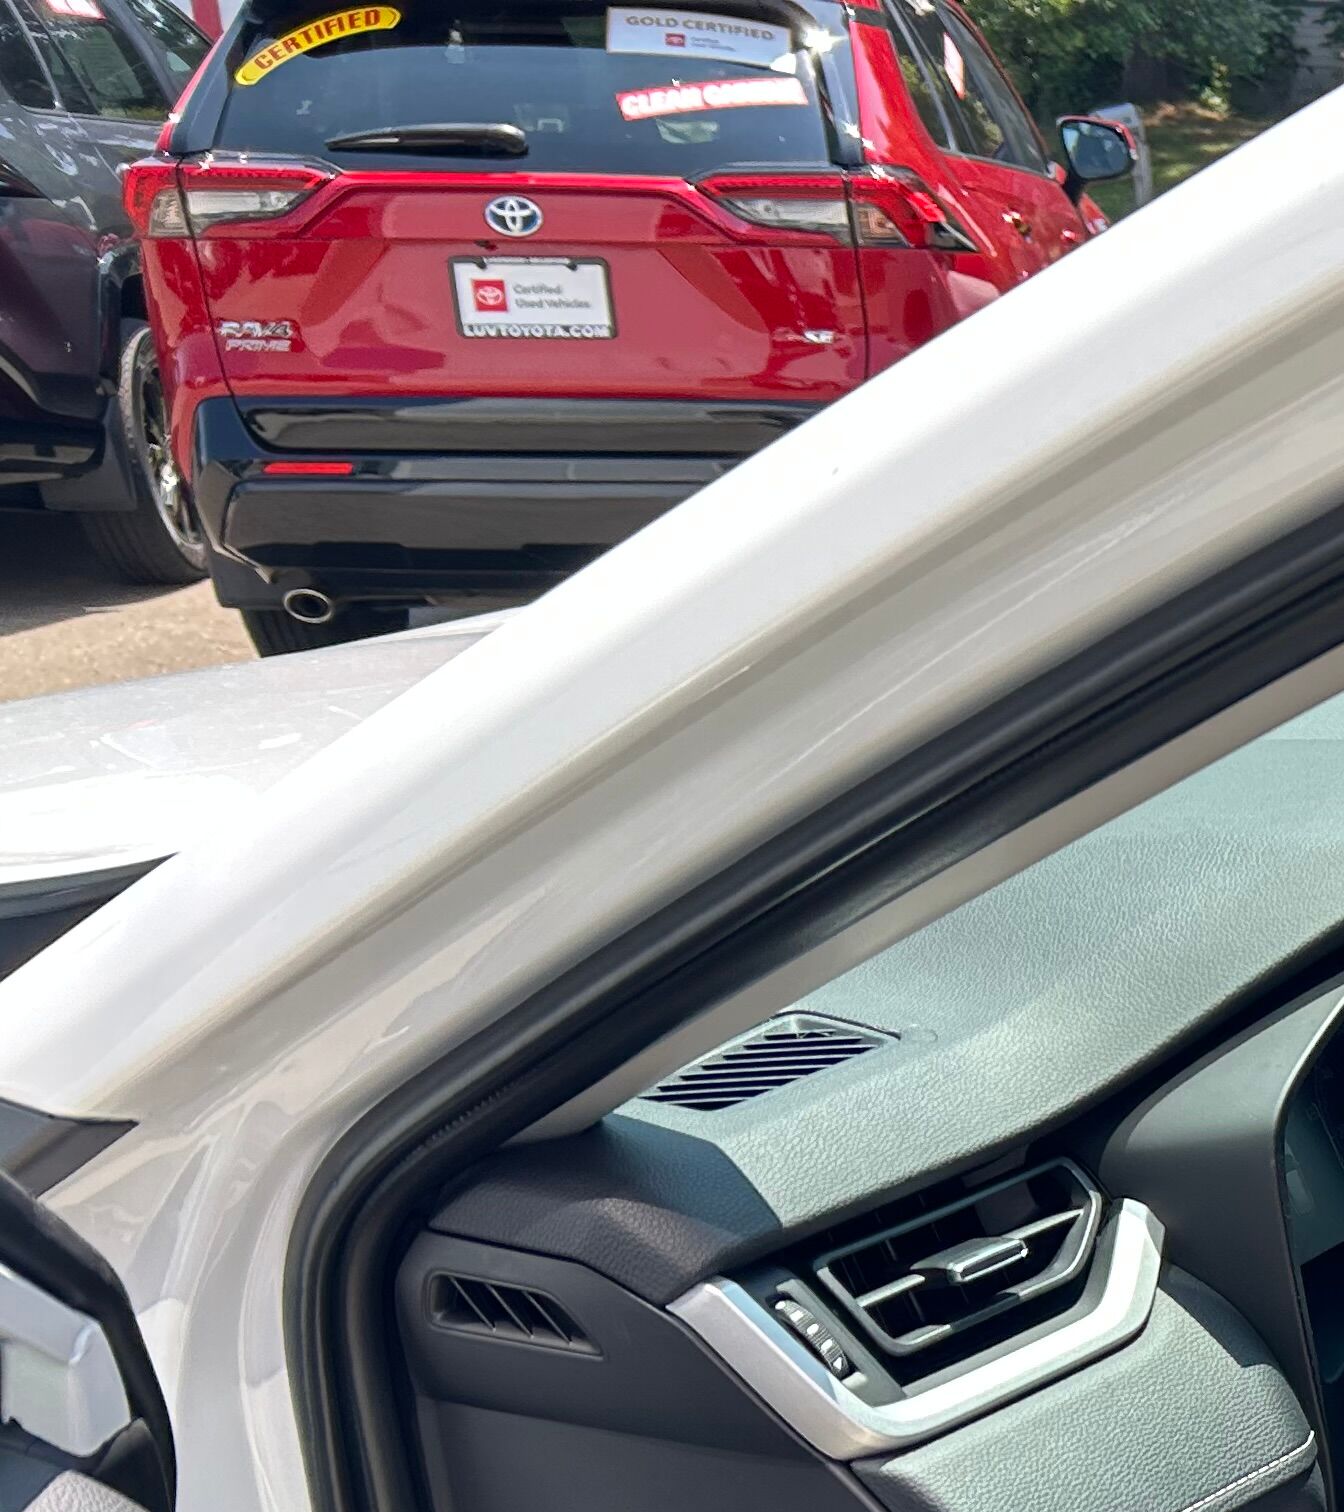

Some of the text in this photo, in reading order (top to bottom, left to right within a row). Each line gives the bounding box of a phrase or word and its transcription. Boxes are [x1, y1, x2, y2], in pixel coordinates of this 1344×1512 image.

[625, 16, 775, 40] GOLD CERTIFIED
[254, 9, 381, 70] CERTIFIED
[513, 283, 563, 295] Certified
[515, 298, 591, 309] Used Vehicles
[219, 320, 293, 338] RAV4
[463, 324, 610, 338] LUVTOYOTA.COM
[225, 339, 292, 352] PRIME
